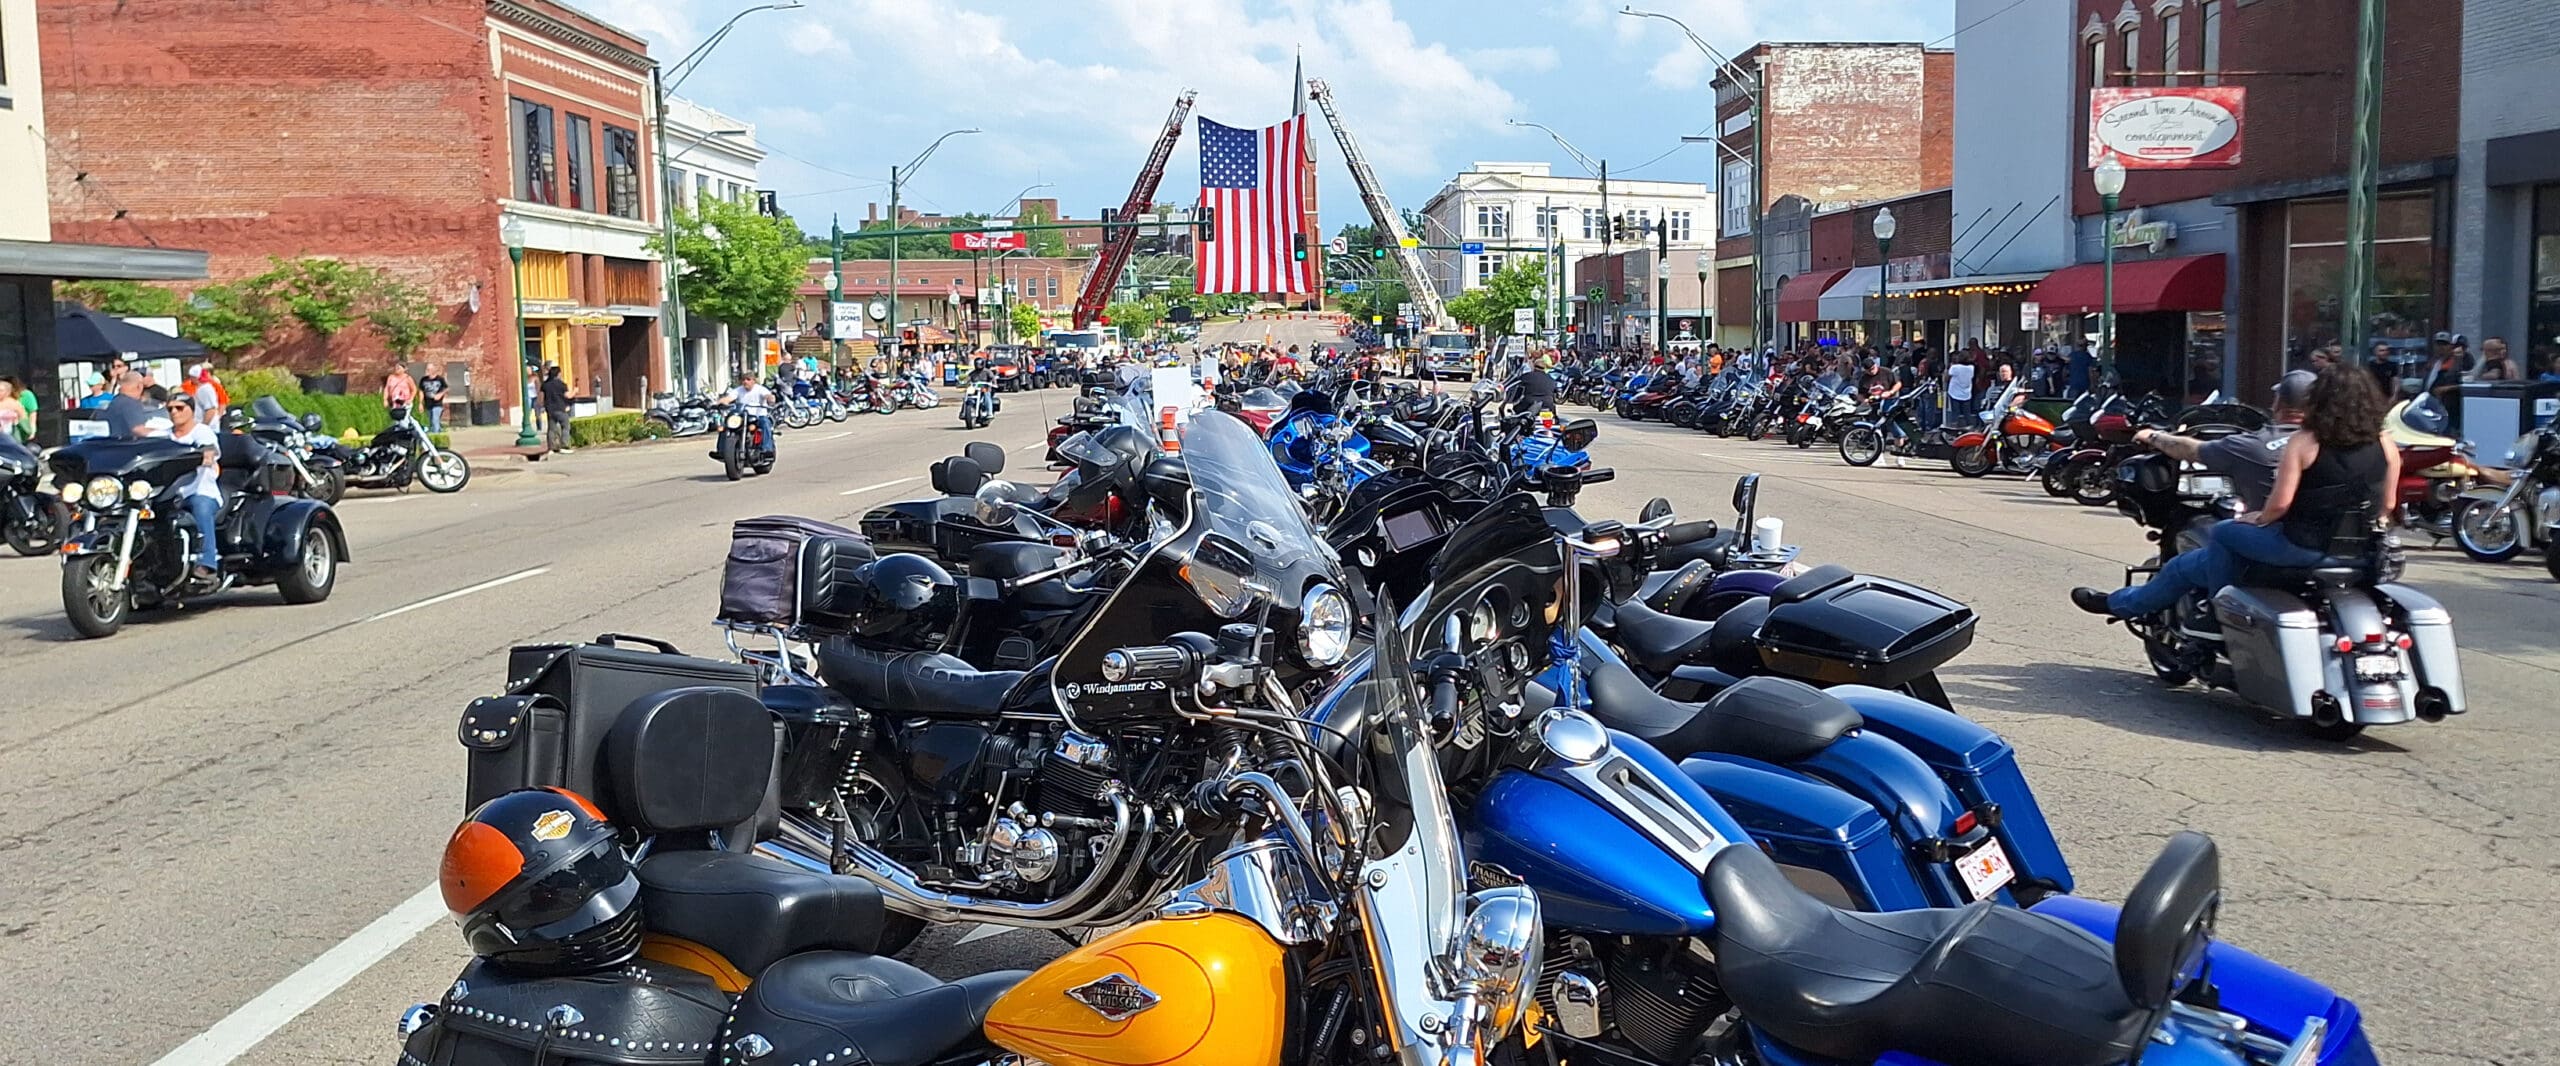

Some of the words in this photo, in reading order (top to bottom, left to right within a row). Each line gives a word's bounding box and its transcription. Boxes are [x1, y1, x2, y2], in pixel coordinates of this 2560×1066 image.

[2104, 103, 2149, 128] Second
[2152, 100, 2177, 116] Time
[2180, 101, 2231, 127] Around
[2124, 130, 2205, 147] consignment
[1083, 681, 1149, 695] Windjammer
[1474, 864, 1515, 886] HARLEY
[1087, 993, 1142, 1010] DAVIDSON
